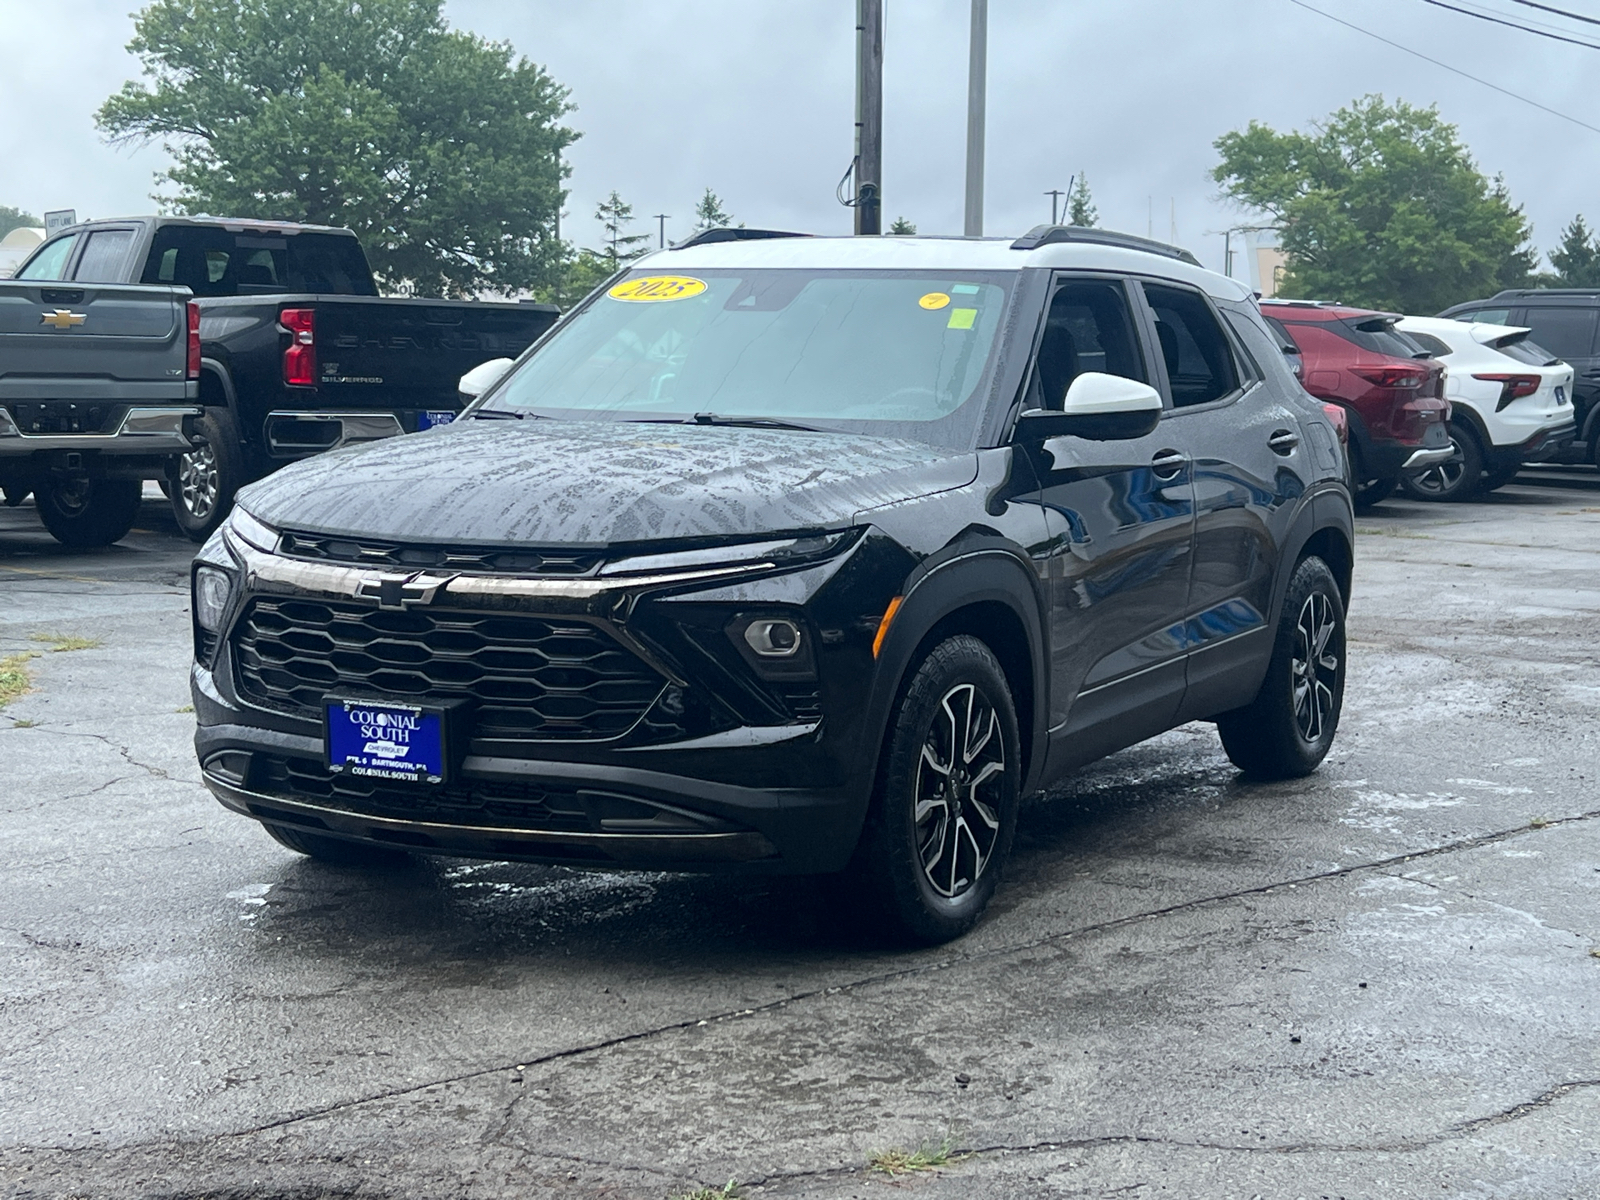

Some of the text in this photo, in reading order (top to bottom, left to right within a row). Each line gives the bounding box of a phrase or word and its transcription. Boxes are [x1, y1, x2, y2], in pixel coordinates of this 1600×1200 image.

[617, 281, 697, 297] 2025
[321, 376, 384, 384] SILVERADO
[349, 710, 421, 731] COLONIAL
[360, 725, 410, 743] SOUTH
[367, 744, 405, 755] CHEVROLET
[352, 766, 419, 781] COLONIAL SOUTH
